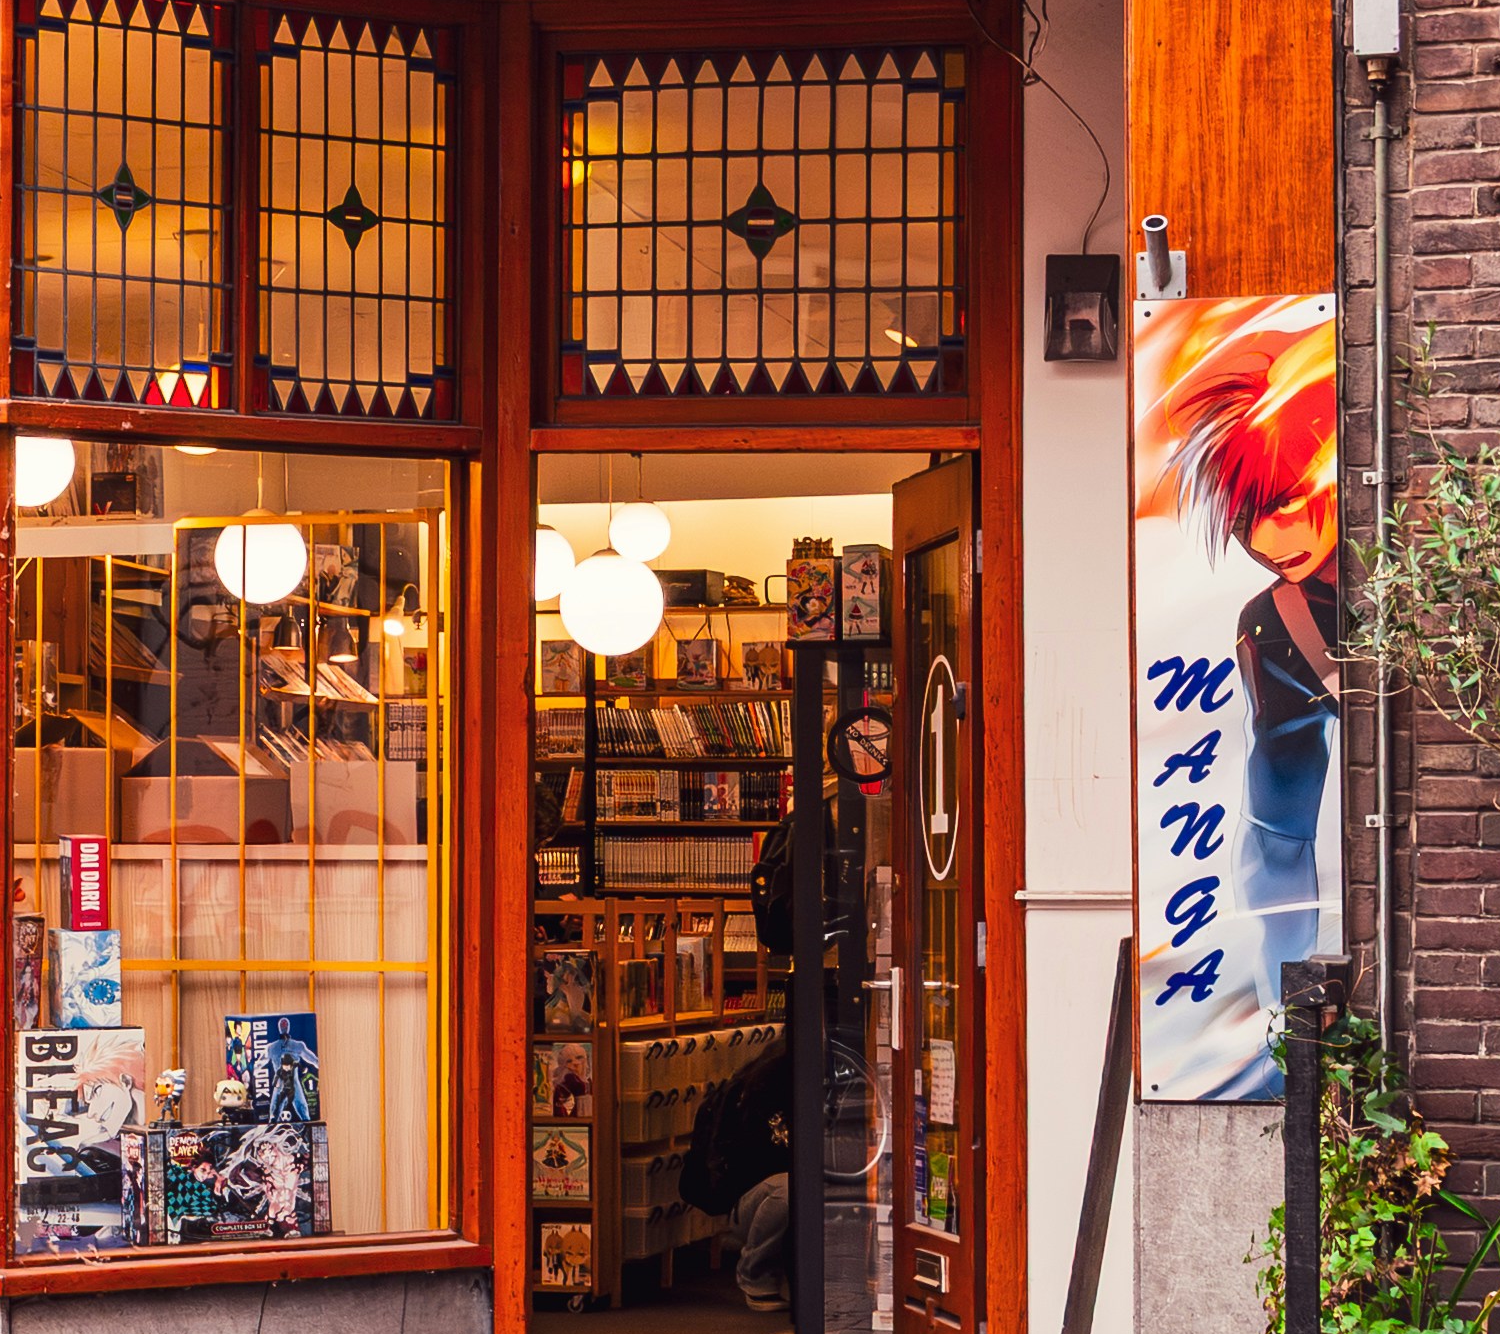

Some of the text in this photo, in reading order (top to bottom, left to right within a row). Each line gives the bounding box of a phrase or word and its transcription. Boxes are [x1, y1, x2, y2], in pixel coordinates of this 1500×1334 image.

[930, 684, 949, 834] 1
[1147, 655, 1236, 1007] MANGA
[80, 843, 100, 868] DAI
[80, 871, 101, 911] DARK
[168, 1145, 200, 1157] SLAYER
[169, 1136, 199, 1147] DEMON
